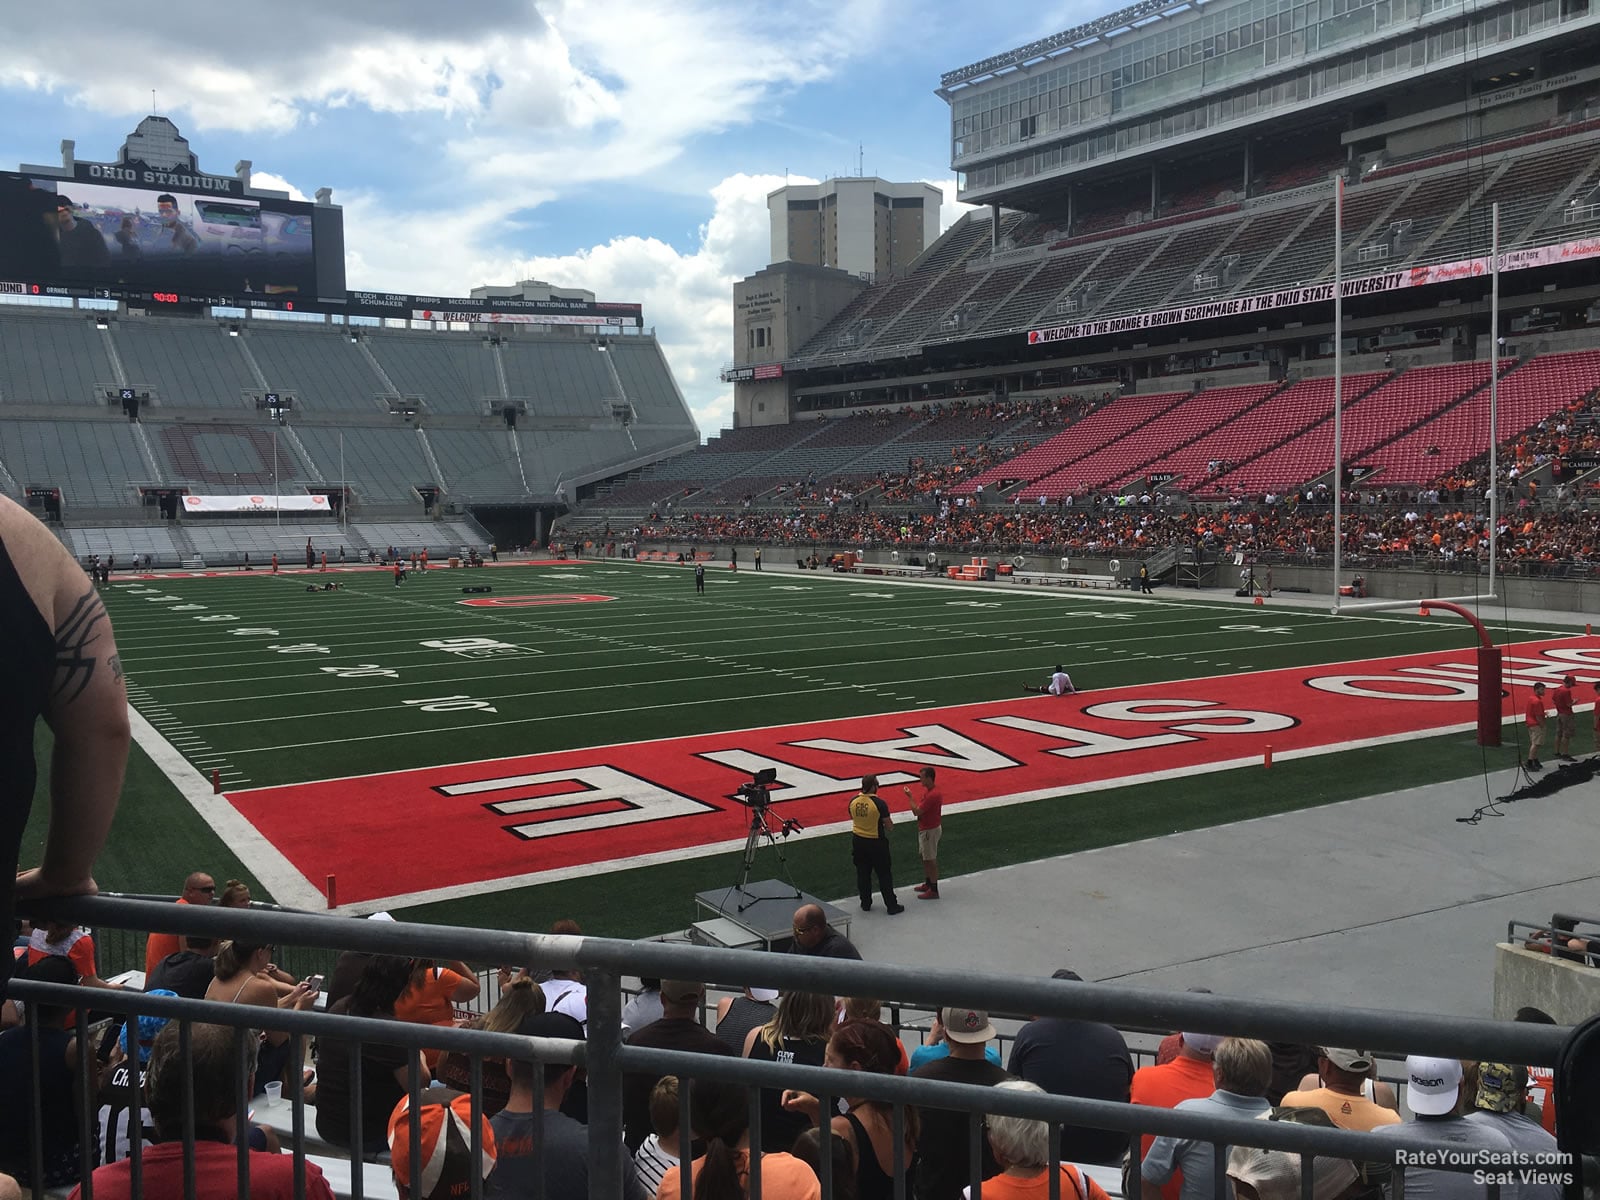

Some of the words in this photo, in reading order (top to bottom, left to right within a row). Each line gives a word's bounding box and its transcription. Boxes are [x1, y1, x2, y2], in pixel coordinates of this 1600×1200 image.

[90, 165, 137, 181] OHIO
[143, 171, 231, 192] STADIUM
[46, 286, 69, 295] ORANGE
[354, 292, 377, 300] BLOCH
[385, 294, 408, 302] CRANE
[416, 296, 441, 304] PHIPPS
[287, 301, 293, 310] 0
[360, 299, 403, 308] SCHUMAKER
[492, 300, 535, 308] HUNTINGTON
[443, 312, 482, 322] WELCOME
[1043, 327, 1081, 341] WELCOME
[1082, 324, 1092, 335] TO
[1093, 321, 1109, 333] THE
[1109, 316, 1142, 332] ORANGE
[1143, 315, 1149, 326] &
[1151, 309, 1183, 326] BROWN
[1184, 302, 1239, 321] SCRIMMAGE
[1240, 299, 1253, 312] AT
[1255, 295, 1273, 309] THE
[1276, 290, 1300, 307] OHIO
[1302, 285, 1335, 302] STATE
[122, 389, 132, 399] 25
[320, 664, 397, 678] 20
[402, 695, 491, 712] 10
[430, 697, 1302, 841] STATE
